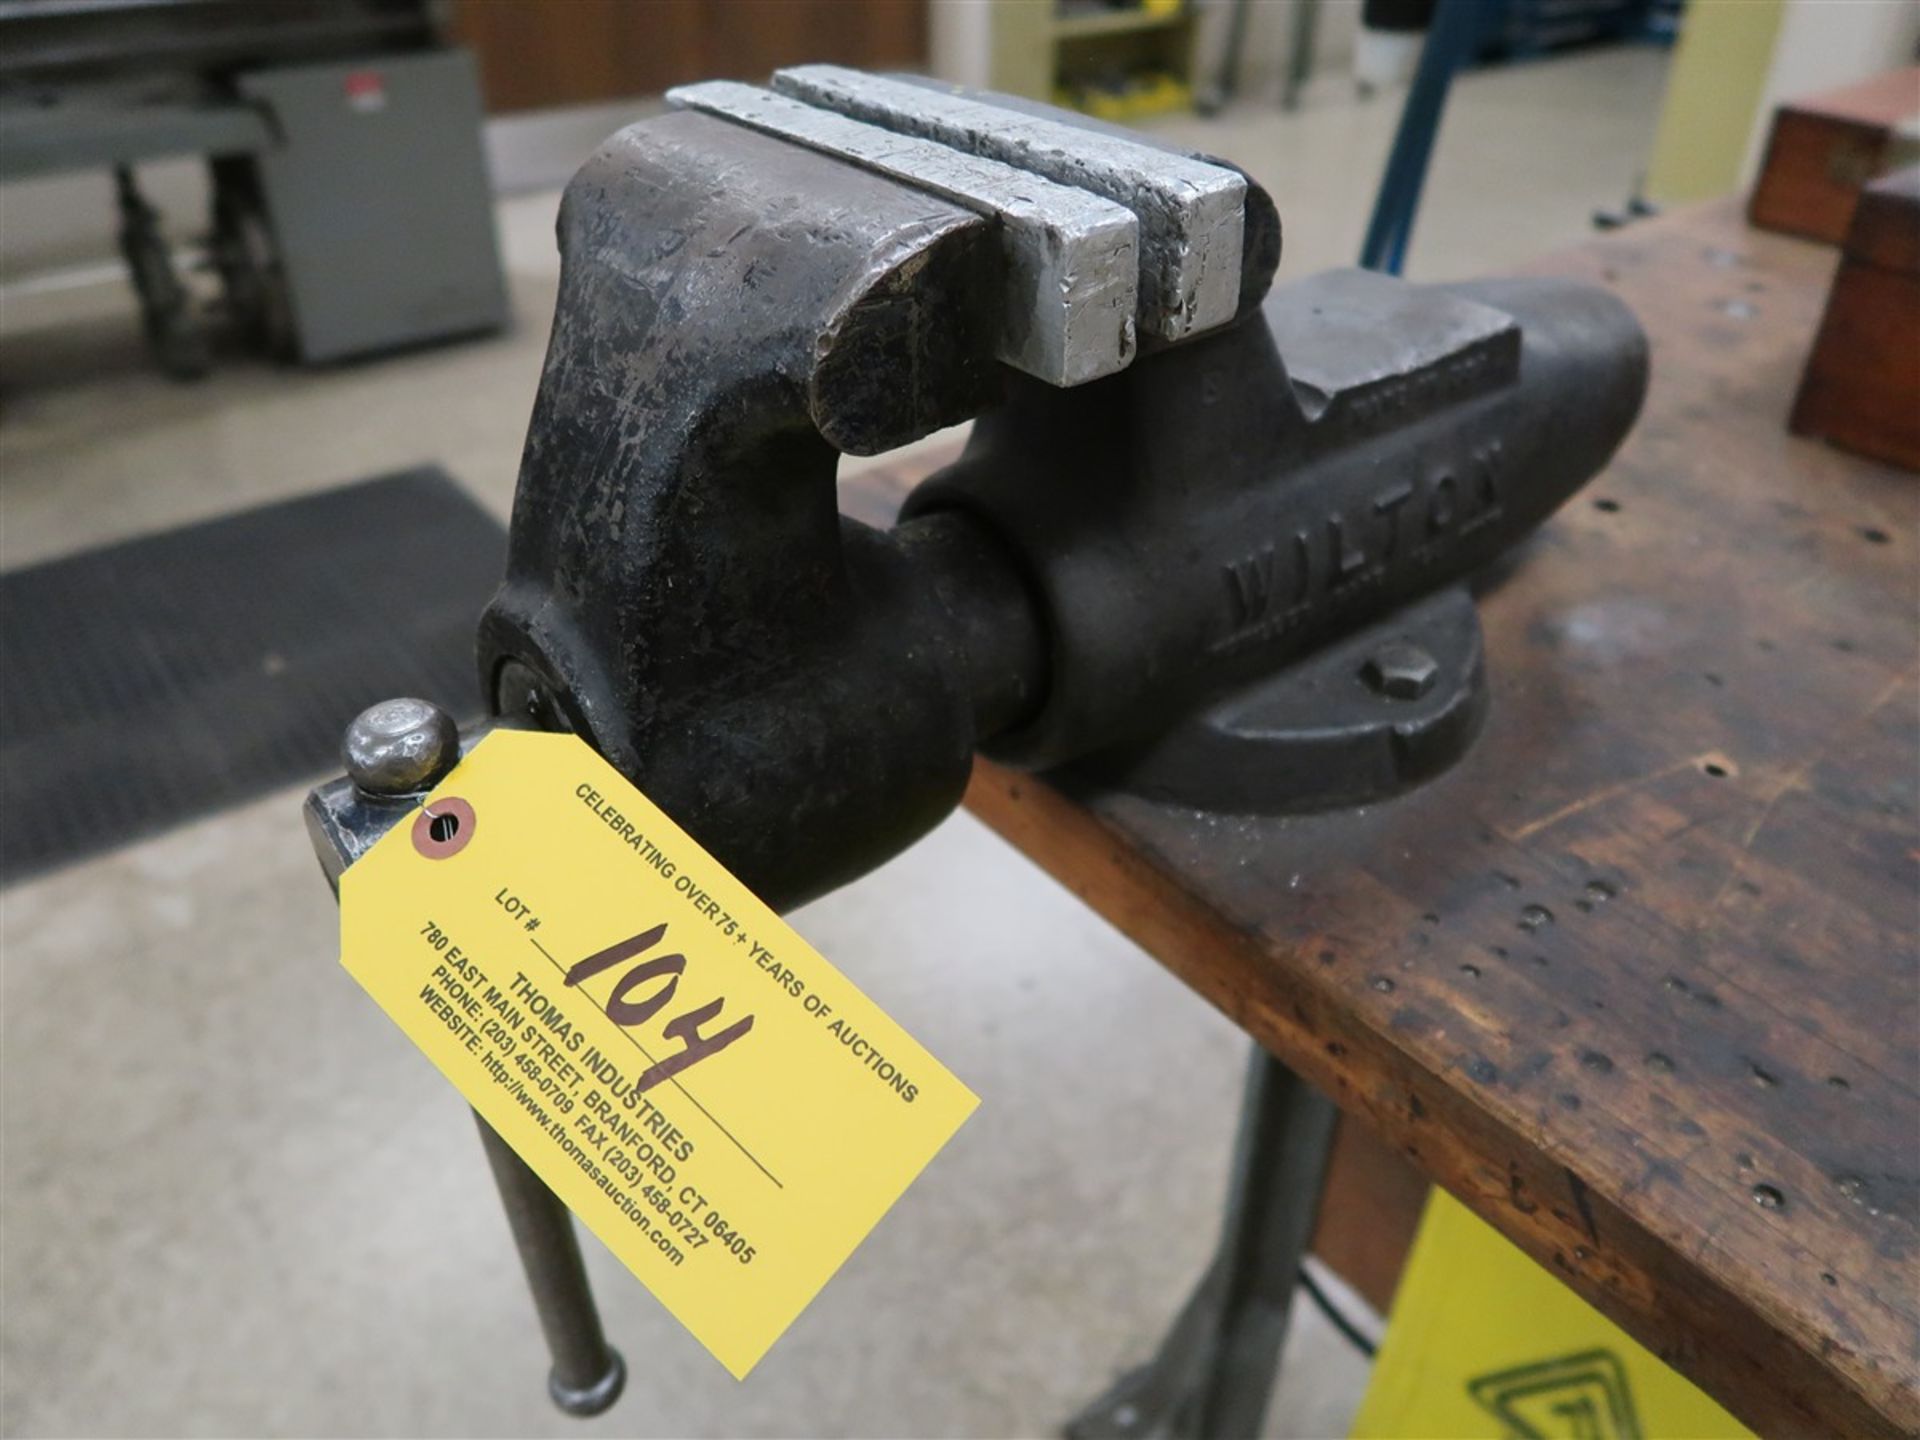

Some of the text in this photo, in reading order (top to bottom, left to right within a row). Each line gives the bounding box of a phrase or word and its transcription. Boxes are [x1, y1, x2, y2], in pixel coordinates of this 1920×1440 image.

[1219, 437, 1504, 622] WILTON
[494, 887, 541, 932] LOT #
[563, 922, 755, 1093] 104
[575, 783, 677, 879] CELEBRATING
[748, 940, 805, 998] YEARS
[803, 994, 832, 1018] OF
[826, 1019, 919, 1103] AUCTIONS
[419, 983, 685, 1267] WEBSITE: http://www.thomasauction.com
[420, 920, 757, 1265] 780 EAST MAIN STREET, BRANFORD, CT 06405
[431, 964, 710, 1249] PHONE: (203) 458-0709 FAX (203) 458-0727
[509, 971, 694, 1162] THOMAS INDUSTRIES
